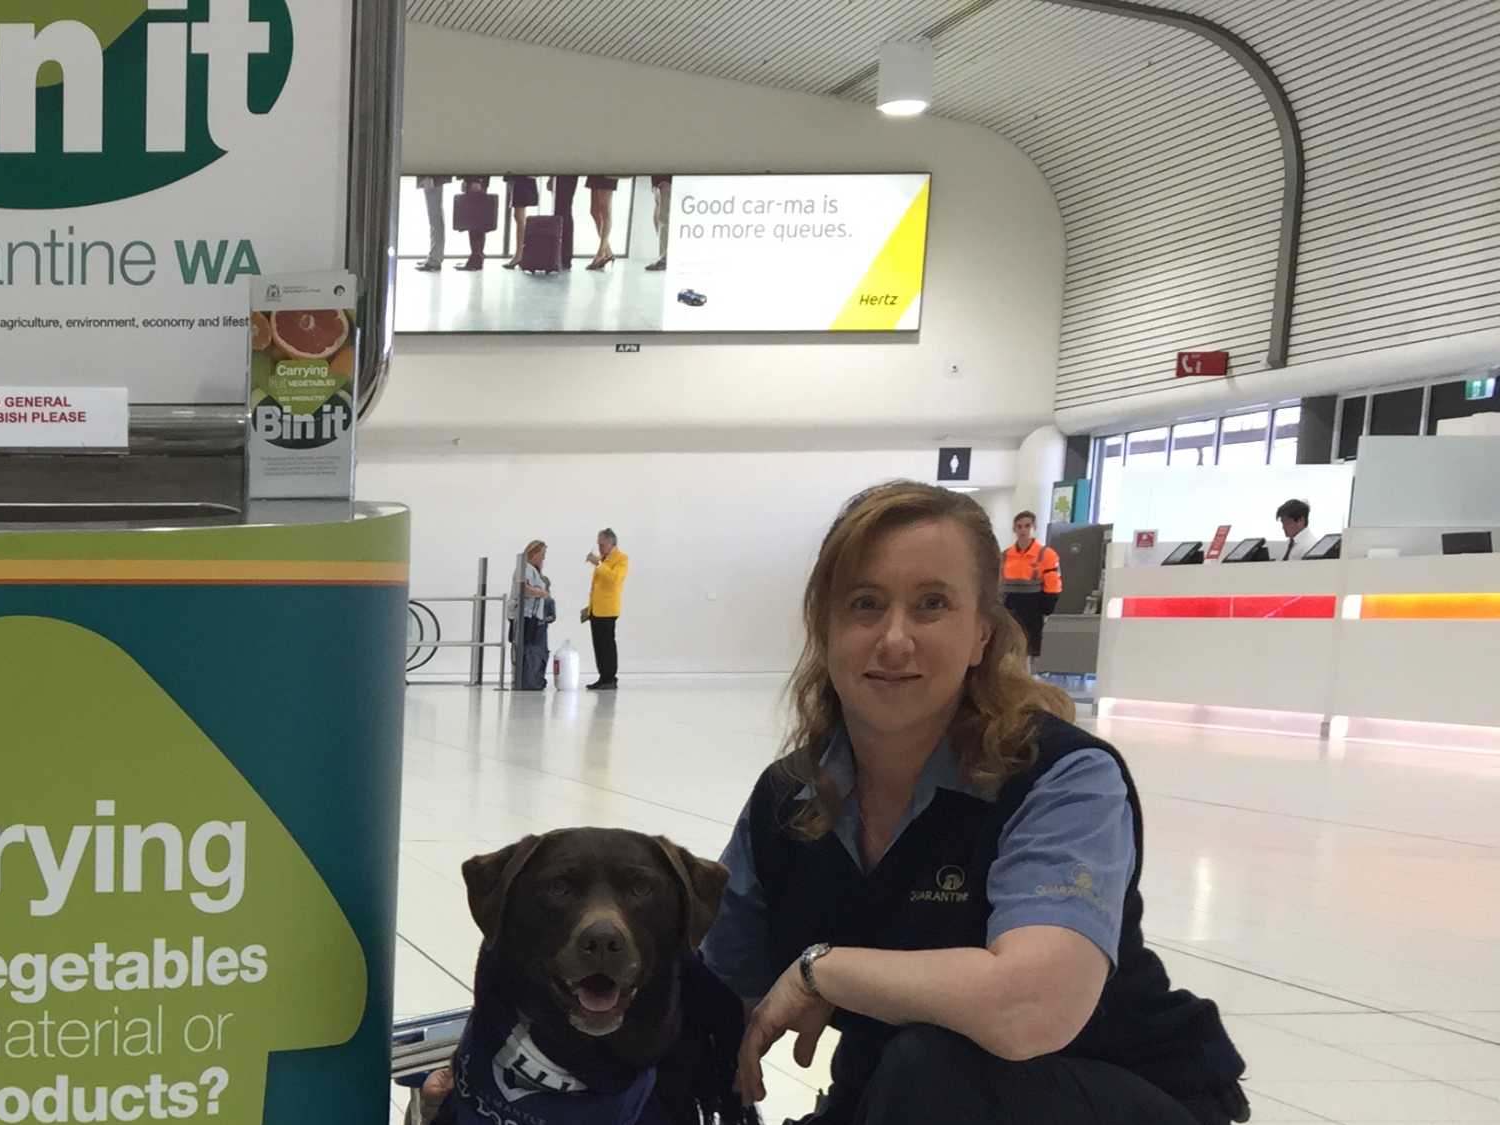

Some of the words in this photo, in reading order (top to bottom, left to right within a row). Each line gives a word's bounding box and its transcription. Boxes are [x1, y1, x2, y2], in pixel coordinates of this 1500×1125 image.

[146, 0, 270, 153] it
[681, 195, 735, 215] Good
[742, 198, 815, 215] car-ma
[822, 194, 839, 214] is
[679, 223, 705, 239] no
[711, 223, 766, 239] more
[773, 222, 853, 242] queues.
[174, 239, 261, 284] WA
[859, 294, 899, 305] Hertz
[0, 316, 62, 331] agriculture,
[65, 316, 139, 329] environment,
[142, 318, 195, 330] economy
[197, 316, 219, 327] and
[276, 364, 329, 378] Carrying
[4, 396, 72, 408] GENERAL
[31, 411, 86, 423] PLEASE
[256, 405, 316, 440] Bin
[321, 404, 348, 440] it
[184, 1010, 233, 1052] or
